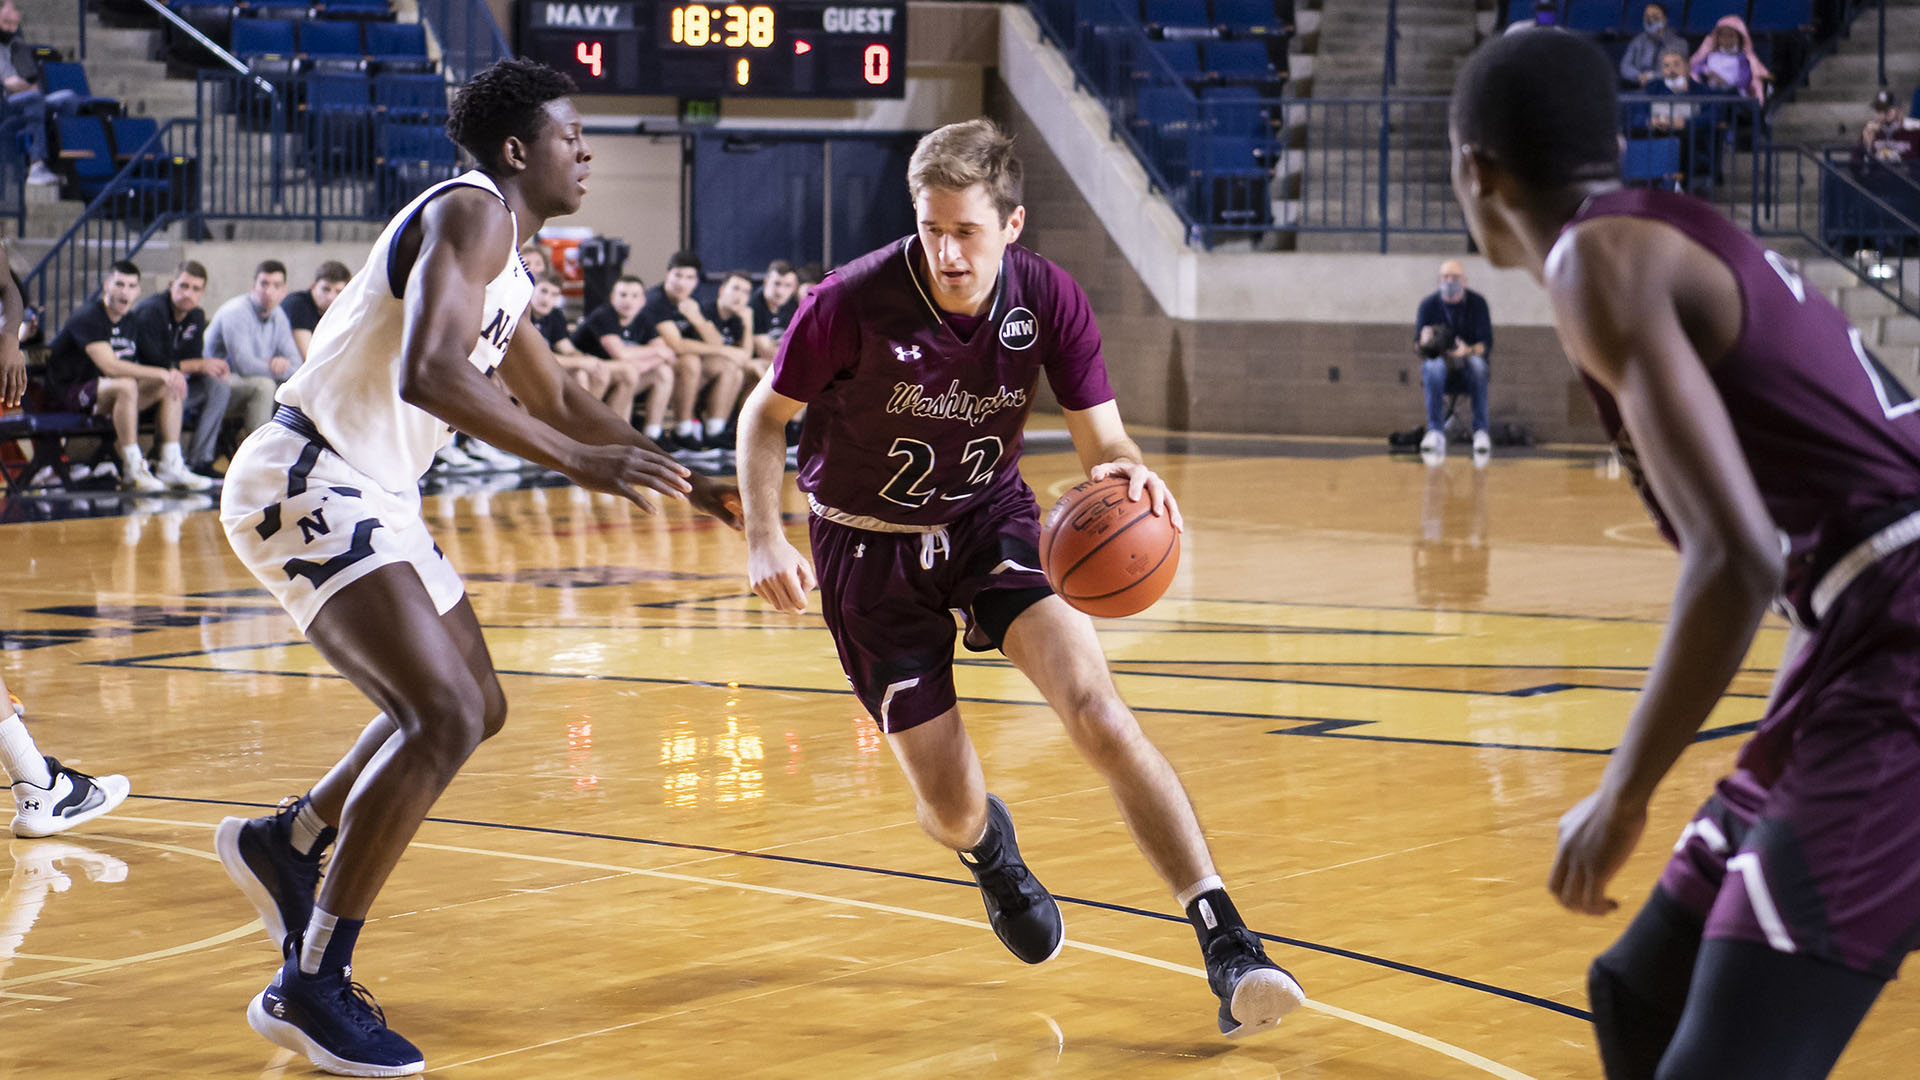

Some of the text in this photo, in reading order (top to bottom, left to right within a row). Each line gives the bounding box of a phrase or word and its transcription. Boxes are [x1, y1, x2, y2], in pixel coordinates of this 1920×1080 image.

[546, 4, 619, 26] NAVY
[672, 5, 775, 48] 18:38
[823, 7, 895, 33] GUEST
[576, 41, 602, 77] 4
[736, 58, 749, 86] 1
[864, 44, 889, 84] 0
[480, 308, 515, 353] NA
[1003, 319, 1034, 339] JNW
[878, 436, 1004, 508] 22
[296, 507, 331, 545] N
